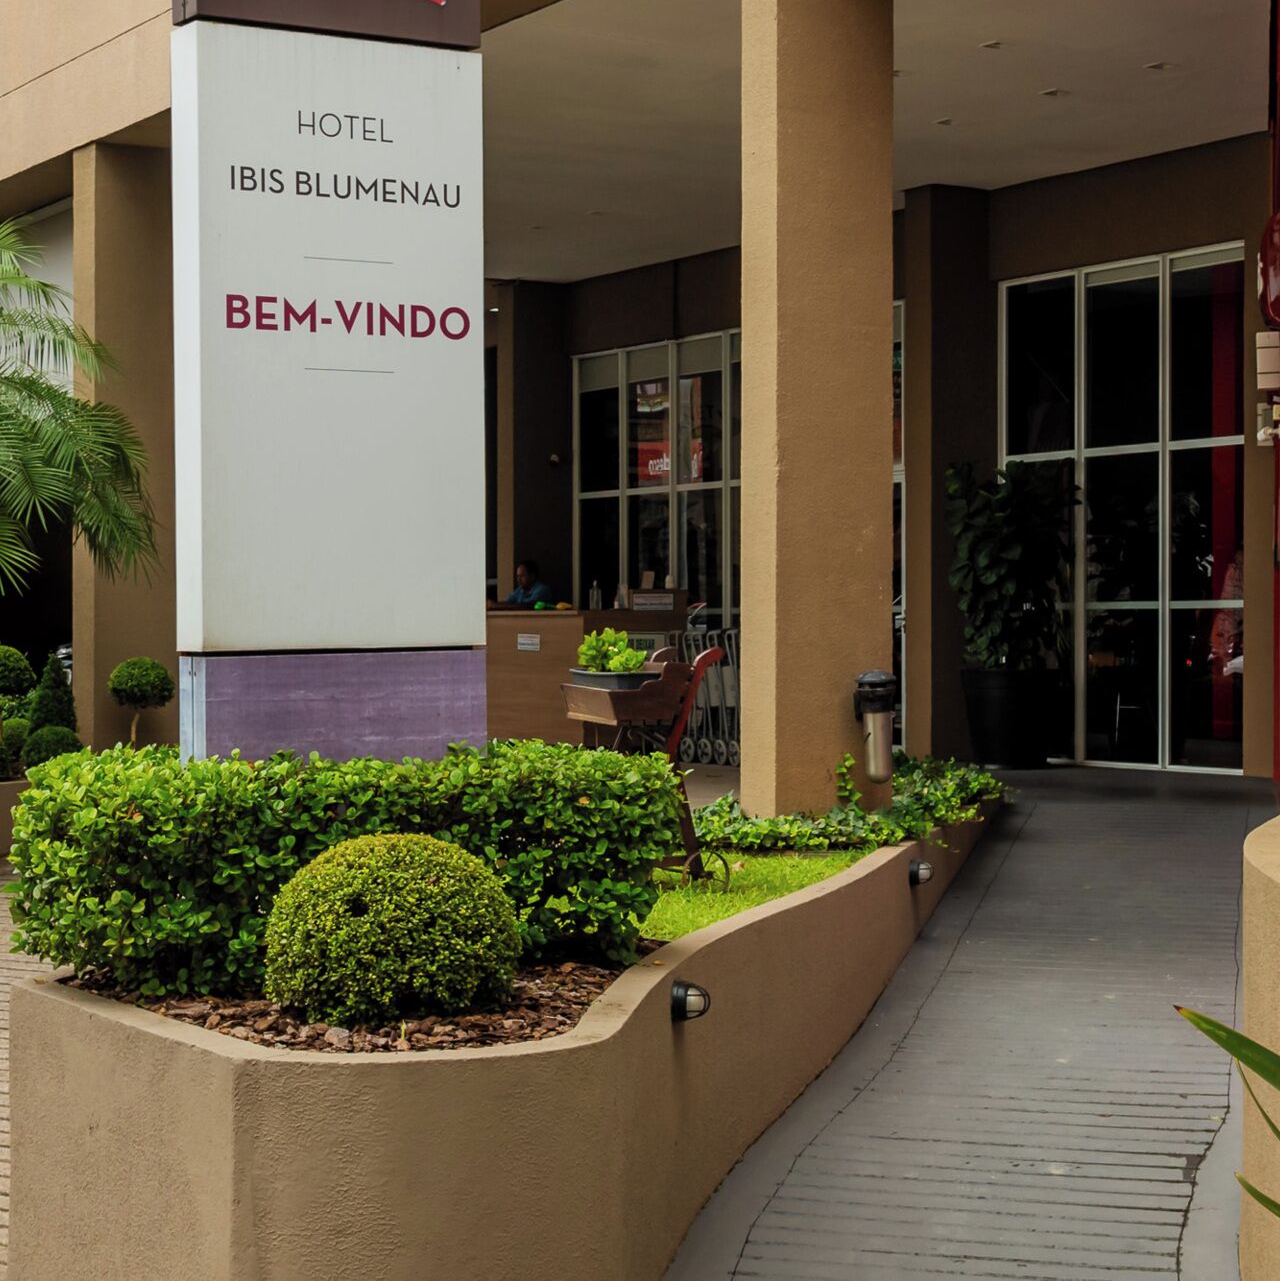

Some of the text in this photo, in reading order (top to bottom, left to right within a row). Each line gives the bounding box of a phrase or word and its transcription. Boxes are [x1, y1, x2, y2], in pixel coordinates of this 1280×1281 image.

[298, 110, 394, 144] HOTEL
[230, 164, 461, 209] IBIS BLUMENAU
[225, 293, 471, 341] BEM-VINDO
